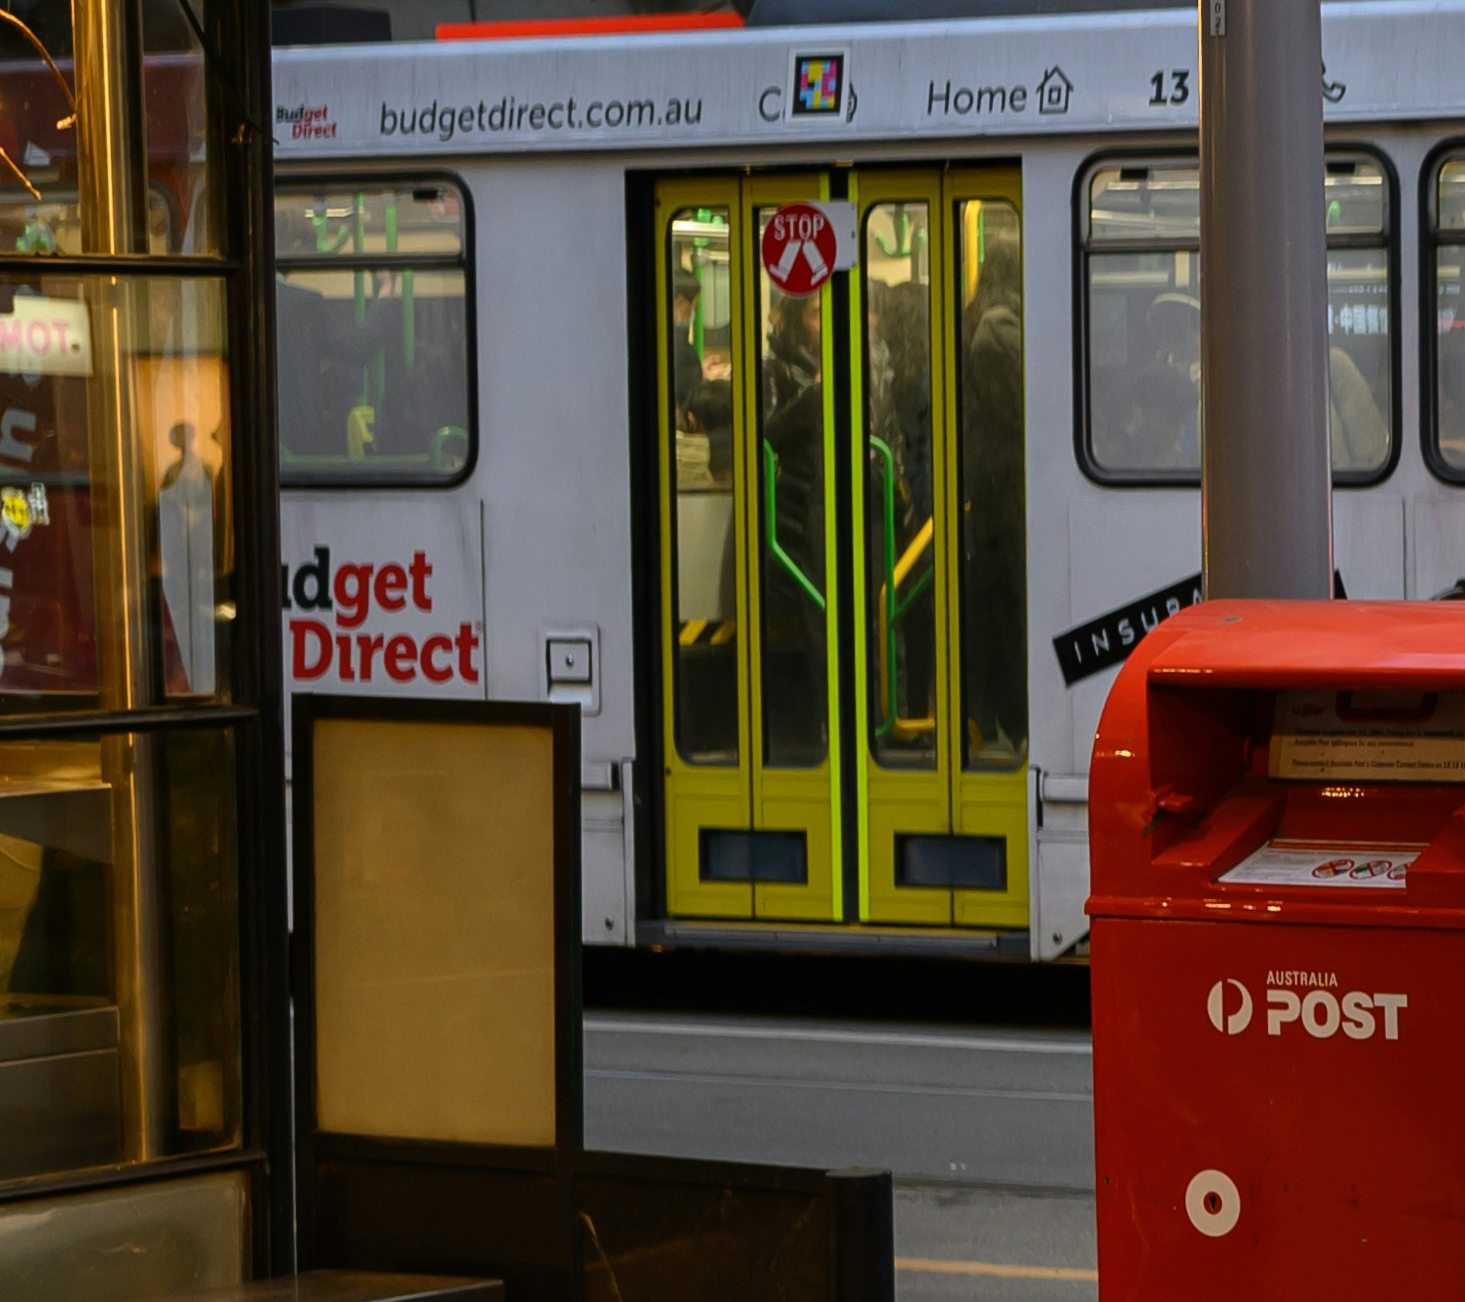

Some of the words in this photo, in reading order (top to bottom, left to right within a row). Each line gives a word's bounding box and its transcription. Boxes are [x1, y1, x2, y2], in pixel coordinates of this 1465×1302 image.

[927, 79, 1028, 116] Home
[1148, 69, 1190, 107] 13
[292, 120, 337, 140] Direct
[380, 96, 703, 141] budgetdirect.com.au
[774, 213, 826, 242] STOP
[289, 620, 480, 683] Direct
[1266, 969, 1338, 988] AUSTRALIA
[1266, 988, 1409, 1041] POST
